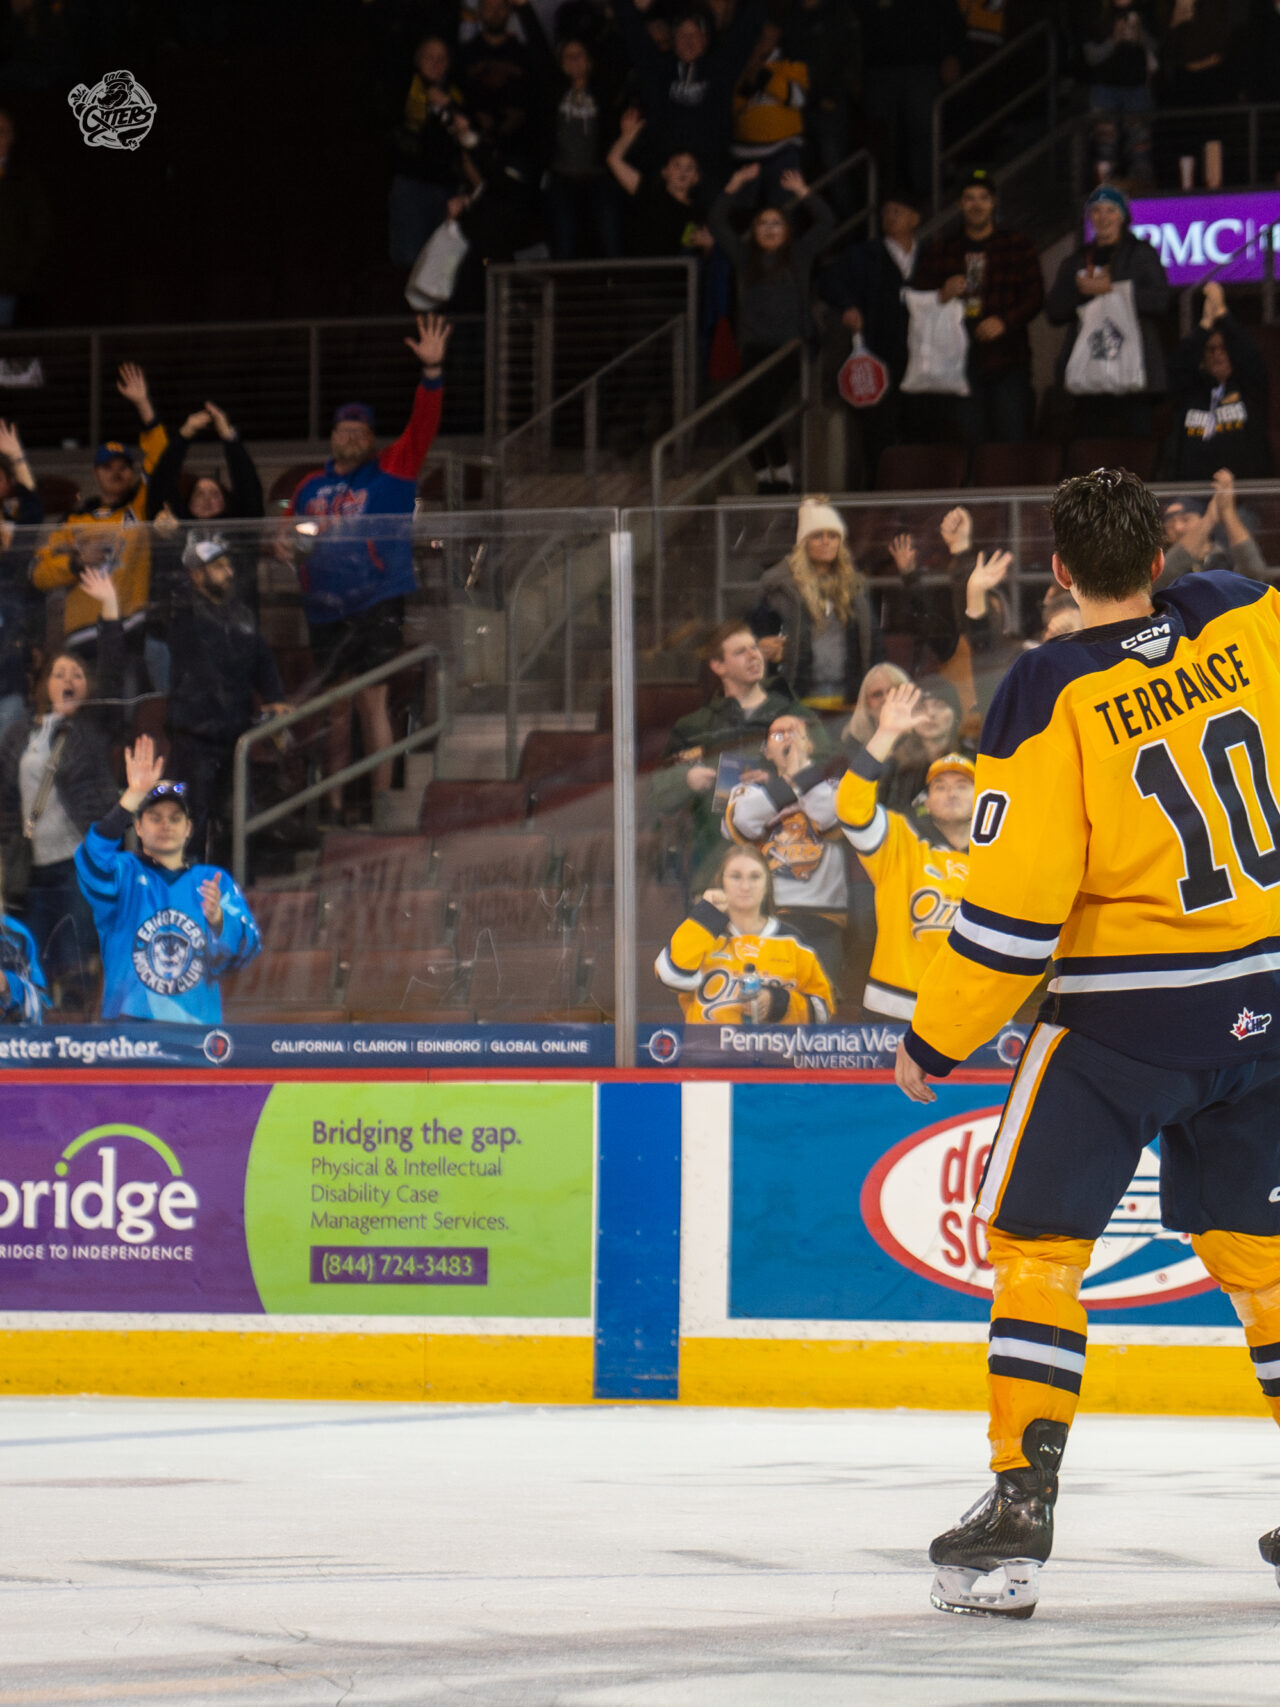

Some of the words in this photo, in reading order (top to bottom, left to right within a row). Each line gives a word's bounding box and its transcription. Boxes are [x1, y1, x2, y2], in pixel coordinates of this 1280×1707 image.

[1120, 622, 1171, 650] CCM
[1094, 643, 1250, 746] TERRANCE
[271, 1040, 343, 1053] CALIFORNIA
[353, 1040, 407, 1053] CLARION
[416, 1040, 480, 1053] EDINBORO
[490, 1040, 538, 1053] GLOBAL
[542, 1040, 588, 1053] ONLINE
[720, 1026, 860, 1059] Pennsylvania
[793, 1055, 878, 1069] UNIVERSITY
[312, 1117, 414, 1152] Bridging
[421, 1118, 463, 1144] the
[471, 1126, 522, 1153] gap.
[311, 1156, 378, 1181] Physical
[385, 1157, 398, 1176] &
[403, 1156, 503, 1177] Intellectual
[311, 1182, 391, 1208] Disability
[396, 1184, 439, 1203] Case
[310, 1211, 427, 1235] Management
[433, 1211, 509, 1230] Services.
[49, 1244, 68, 1260] TO
[72, 1244, 194, 1261] INDEPENDENCE
[322, 1252, 374, 1281] (844)
[380, 1255, 473, 1276] 724-3483
